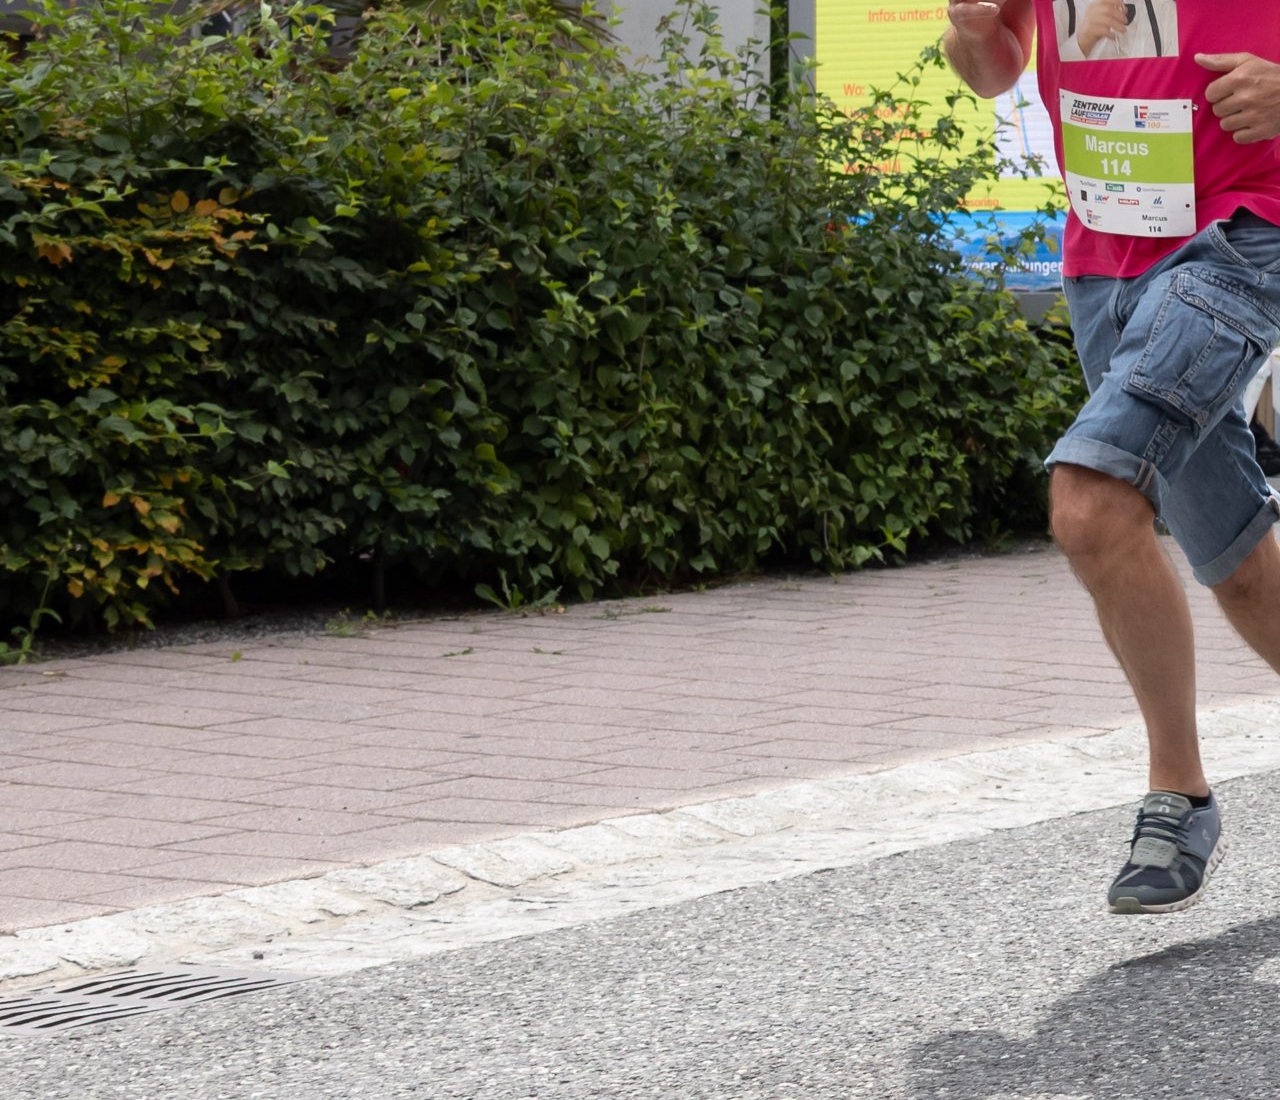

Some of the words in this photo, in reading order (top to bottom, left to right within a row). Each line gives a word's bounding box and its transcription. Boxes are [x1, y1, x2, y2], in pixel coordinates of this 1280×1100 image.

[868, 7, 896, 23] Infos
[843, 83, 865, 97] Wo:
[1073, 99, 1114, 113] ZENTRUM
[1085, 134, 1149, 156] Marcus
[1101, 158, 1132, 176] 114
[1142, 214, 1168, 222] Marcus
